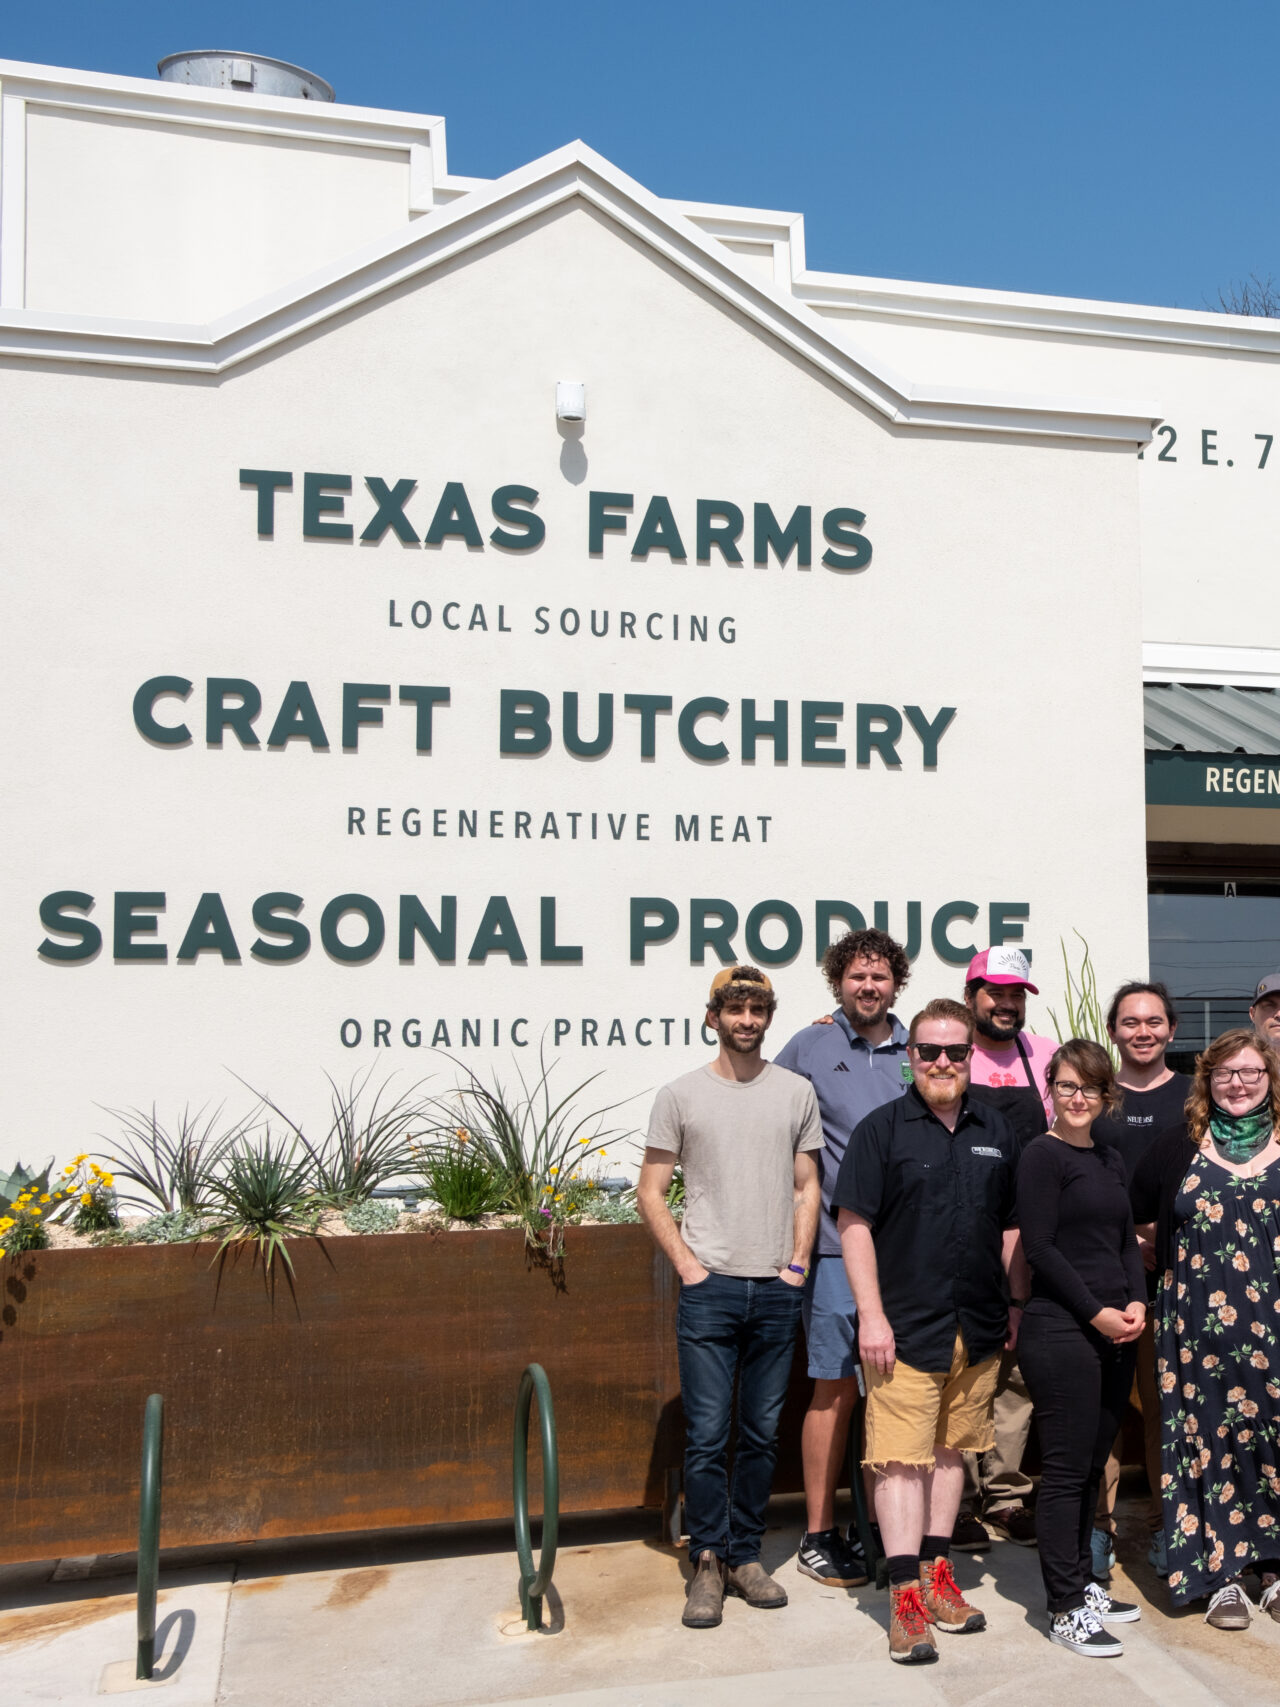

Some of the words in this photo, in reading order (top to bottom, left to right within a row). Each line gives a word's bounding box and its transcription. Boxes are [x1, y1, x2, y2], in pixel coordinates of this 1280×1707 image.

[1138, 425, 1177, 462] 2
[1202, 430, 1233, 466] E.
[240, 469, 545, 550] TEXAS
[589, 492, 872, 570] FARMS
[390, 600, 511, 631] LOCAL
[535, 607, 735, 643] SOURCING
[133, 676, 450, 751] CRAFT
[500, 690, 956, 767] BUTCHERY
[348, 807, 649, 840] REGENERATIVE
[676, 815, 771, 842] MEAT
[1225, 882, 1236, 898] A
[38, 891, 582, 962] SEASONAL
[341, 1019, 528, 1048] ORGANIC
[554, 1018, 764, 1046] PRACTIC
